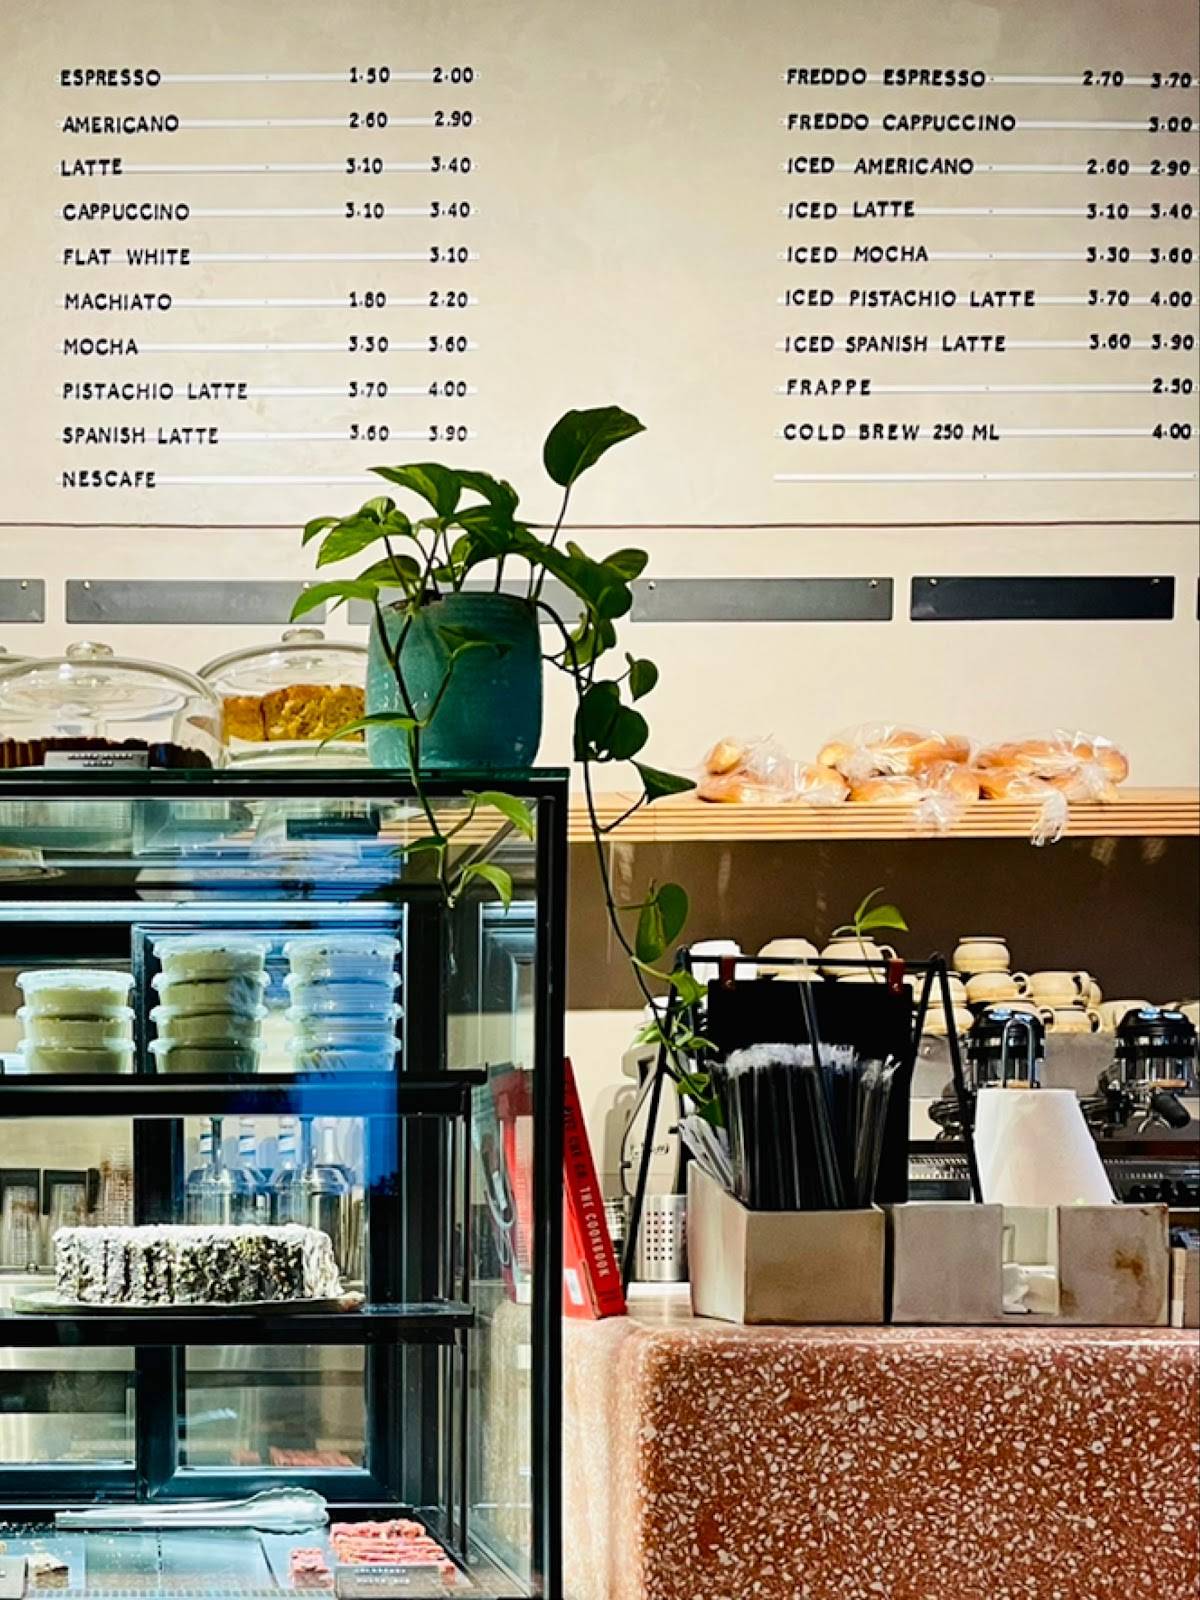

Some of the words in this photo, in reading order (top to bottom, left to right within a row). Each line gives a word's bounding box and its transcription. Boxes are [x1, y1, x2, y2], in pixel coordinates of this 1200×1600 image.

[61, 69, 160, 86] ESPRESSO
[787, 68, 867, 85] FREDDO
[883, 69, 986, 87] ESPRESSO
[63, 115, 179, 134] AMERICANO
[788, 114, 869, 130] FREDDO
[883, 114, 1016, 131] CAPPUCCINO
[61, 158, 123, 176] LATTE
[788, 157, 835, 174] ICED
[854, 158, 974, 174] AMERICANO
[63, 203, 190, 221] CAPPUCCINO
[788, 202, 837, 219] ICED
[853, 201, 915, 218] LATTE
[64, 248, 112, 265] FLAT
[127, 249, 190, 265] WHITE
[787, 246, 837, 263] ICED
[853, 246, 929, 262] MOCHA
[65, 293, 172, 310] MACHIATO
[786, 290, 834, 306] ICED
[850, 290, 956, 307] PISTACHIO
[970, 290, 1035, 306] LATTE
[64, 338, 138, 355] MOCHA
[785, 336, 835, 353] ICED
[845, 335, 928, 352] SPANISH
[942, 335, 1006, 351] LATTE
[63, 383, 174, 400] PISTACHIO
[187, 383, 248, 400] LATTE
[787, 379, 871, 396] FRAPPE
[62, 426, 145, 444] SPANISH
[158, 427, 219, 444] LATTE
[783, 423, 846, 440] COLD
[859, 423, 920, 440] BREW
[972, 424, 1000, 440] ML
[62, 470, 156, 488] NESCAFE
[579, 1186, 594, 1208] THE
[585, 1212, 611, 1278] COOKBOOK
